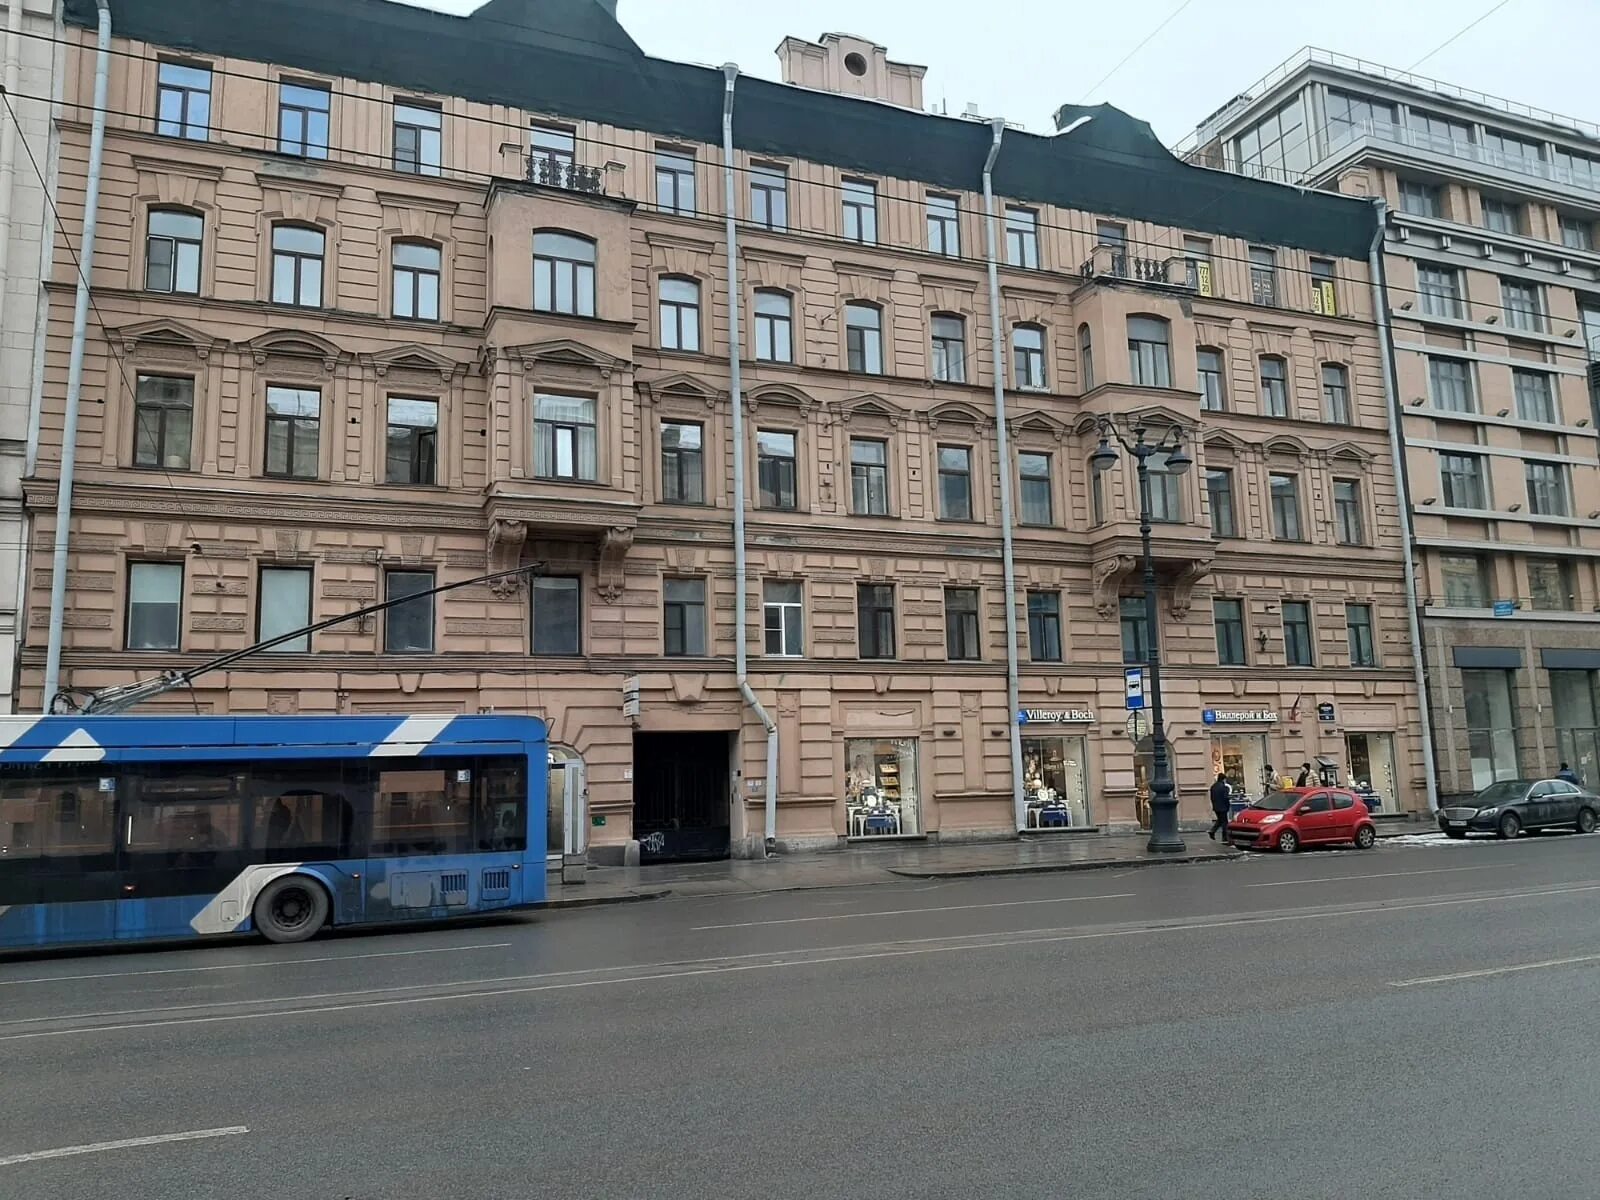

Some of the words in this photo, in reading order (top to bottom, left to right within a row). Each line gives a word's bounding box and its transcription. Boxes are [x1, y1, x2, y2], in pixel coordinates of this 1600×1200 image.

[1200, 266, 1209, 275] 777
[1201, 275, 1208, 284] 12
[1026, 709, 1060, 722] Villeroy
[1071, 709, 1094, 719] Boch
[1215, 710, 1255, 722] Виллерой
[1262, 709, 1278, 719] Бох
